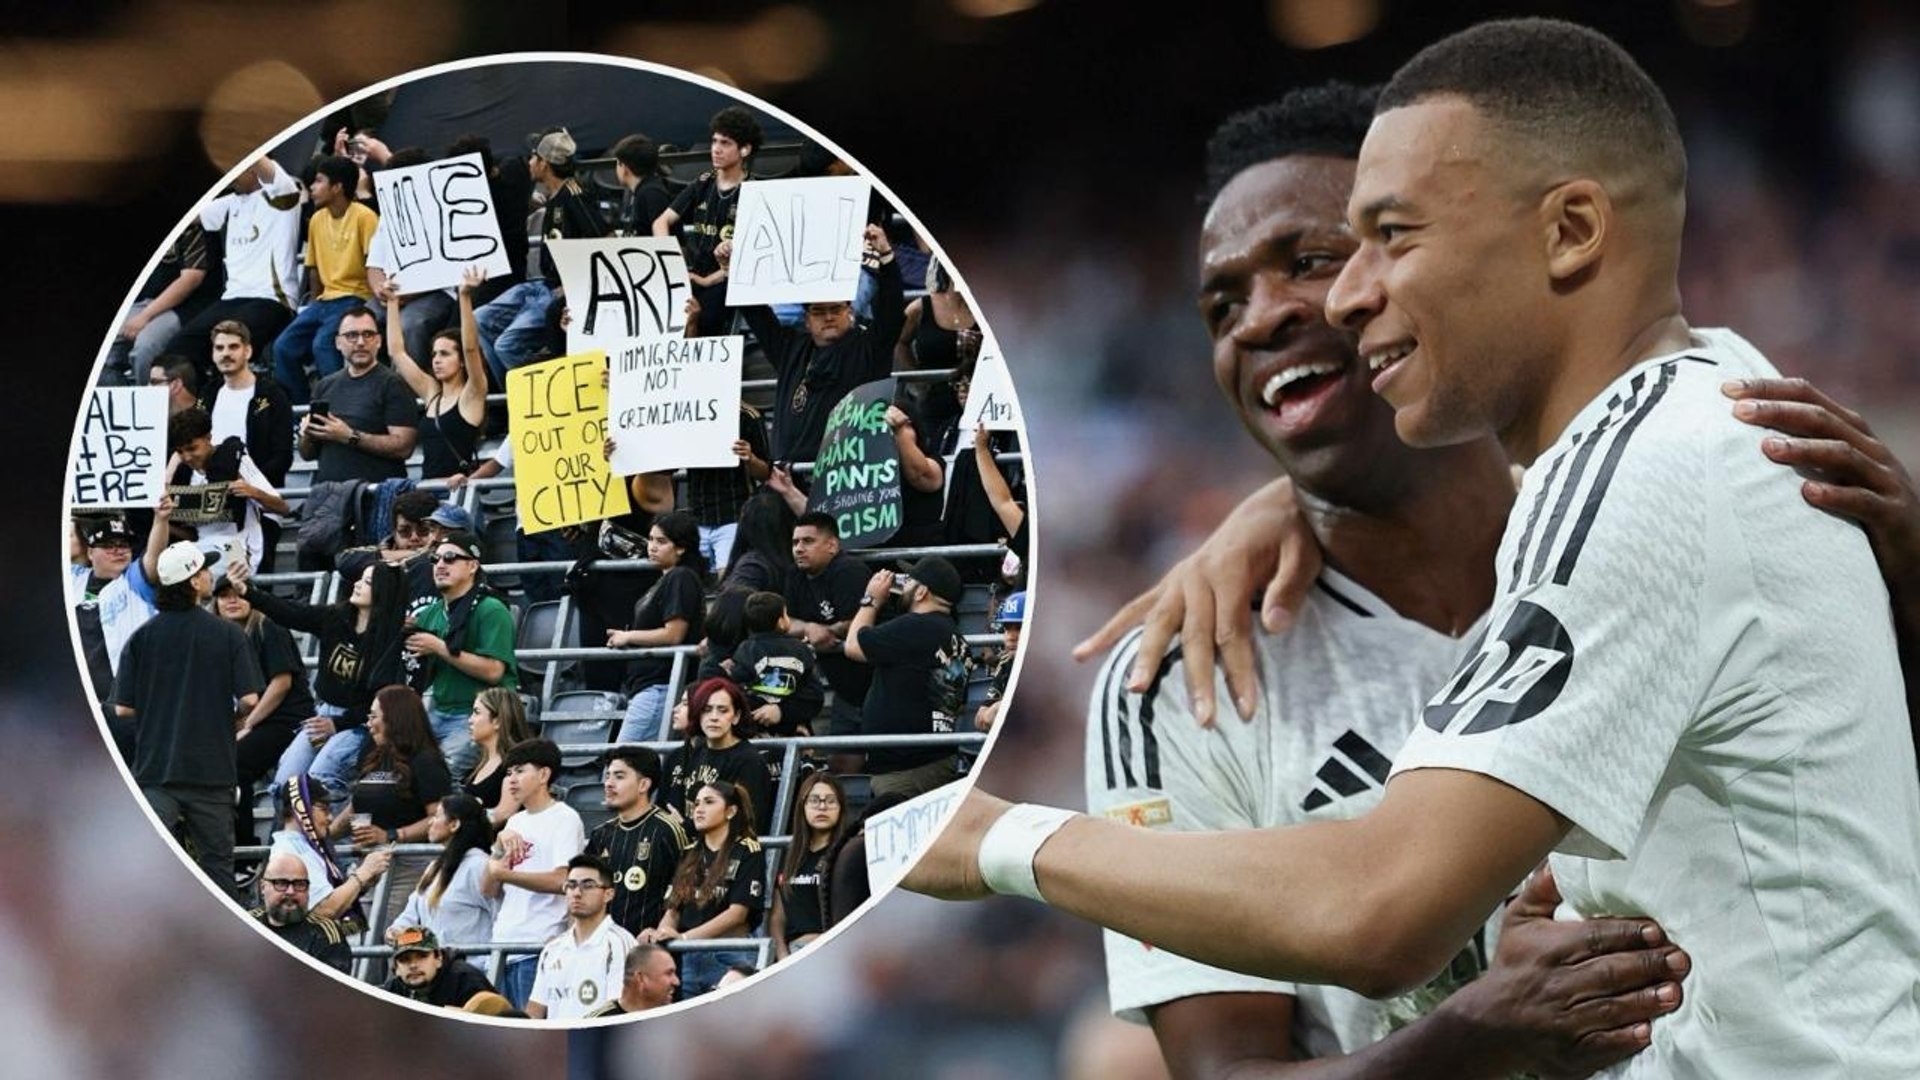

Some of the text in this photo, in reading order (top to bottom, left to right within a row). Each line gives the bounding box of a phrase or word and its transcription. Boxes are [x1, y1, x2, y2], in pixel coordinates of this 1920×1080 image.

[379, 162, 498, 270] WE
[731, 191, 863, 286] ALL
[582, 248, 685, 337] ARE
[620, 338, 731, 374] IMMIGRANTS
[523, 361, 598, 419] ICE
[643, 368, 682, 393] NOT
[84, 390, 155, 434] ALL
[619, 399, 719, 429] CRIMINALS
[105, 435, 152, 470] Be
[522, 418, 608, 454] OUT OF
[555, 453, 596, 481] OUR
[826, 458, 897, 496] PANTS
[72, 469, 149, 504] ERE
[532, 473, 611, 525] CITY
[837, 503, 897, 539] CISM
